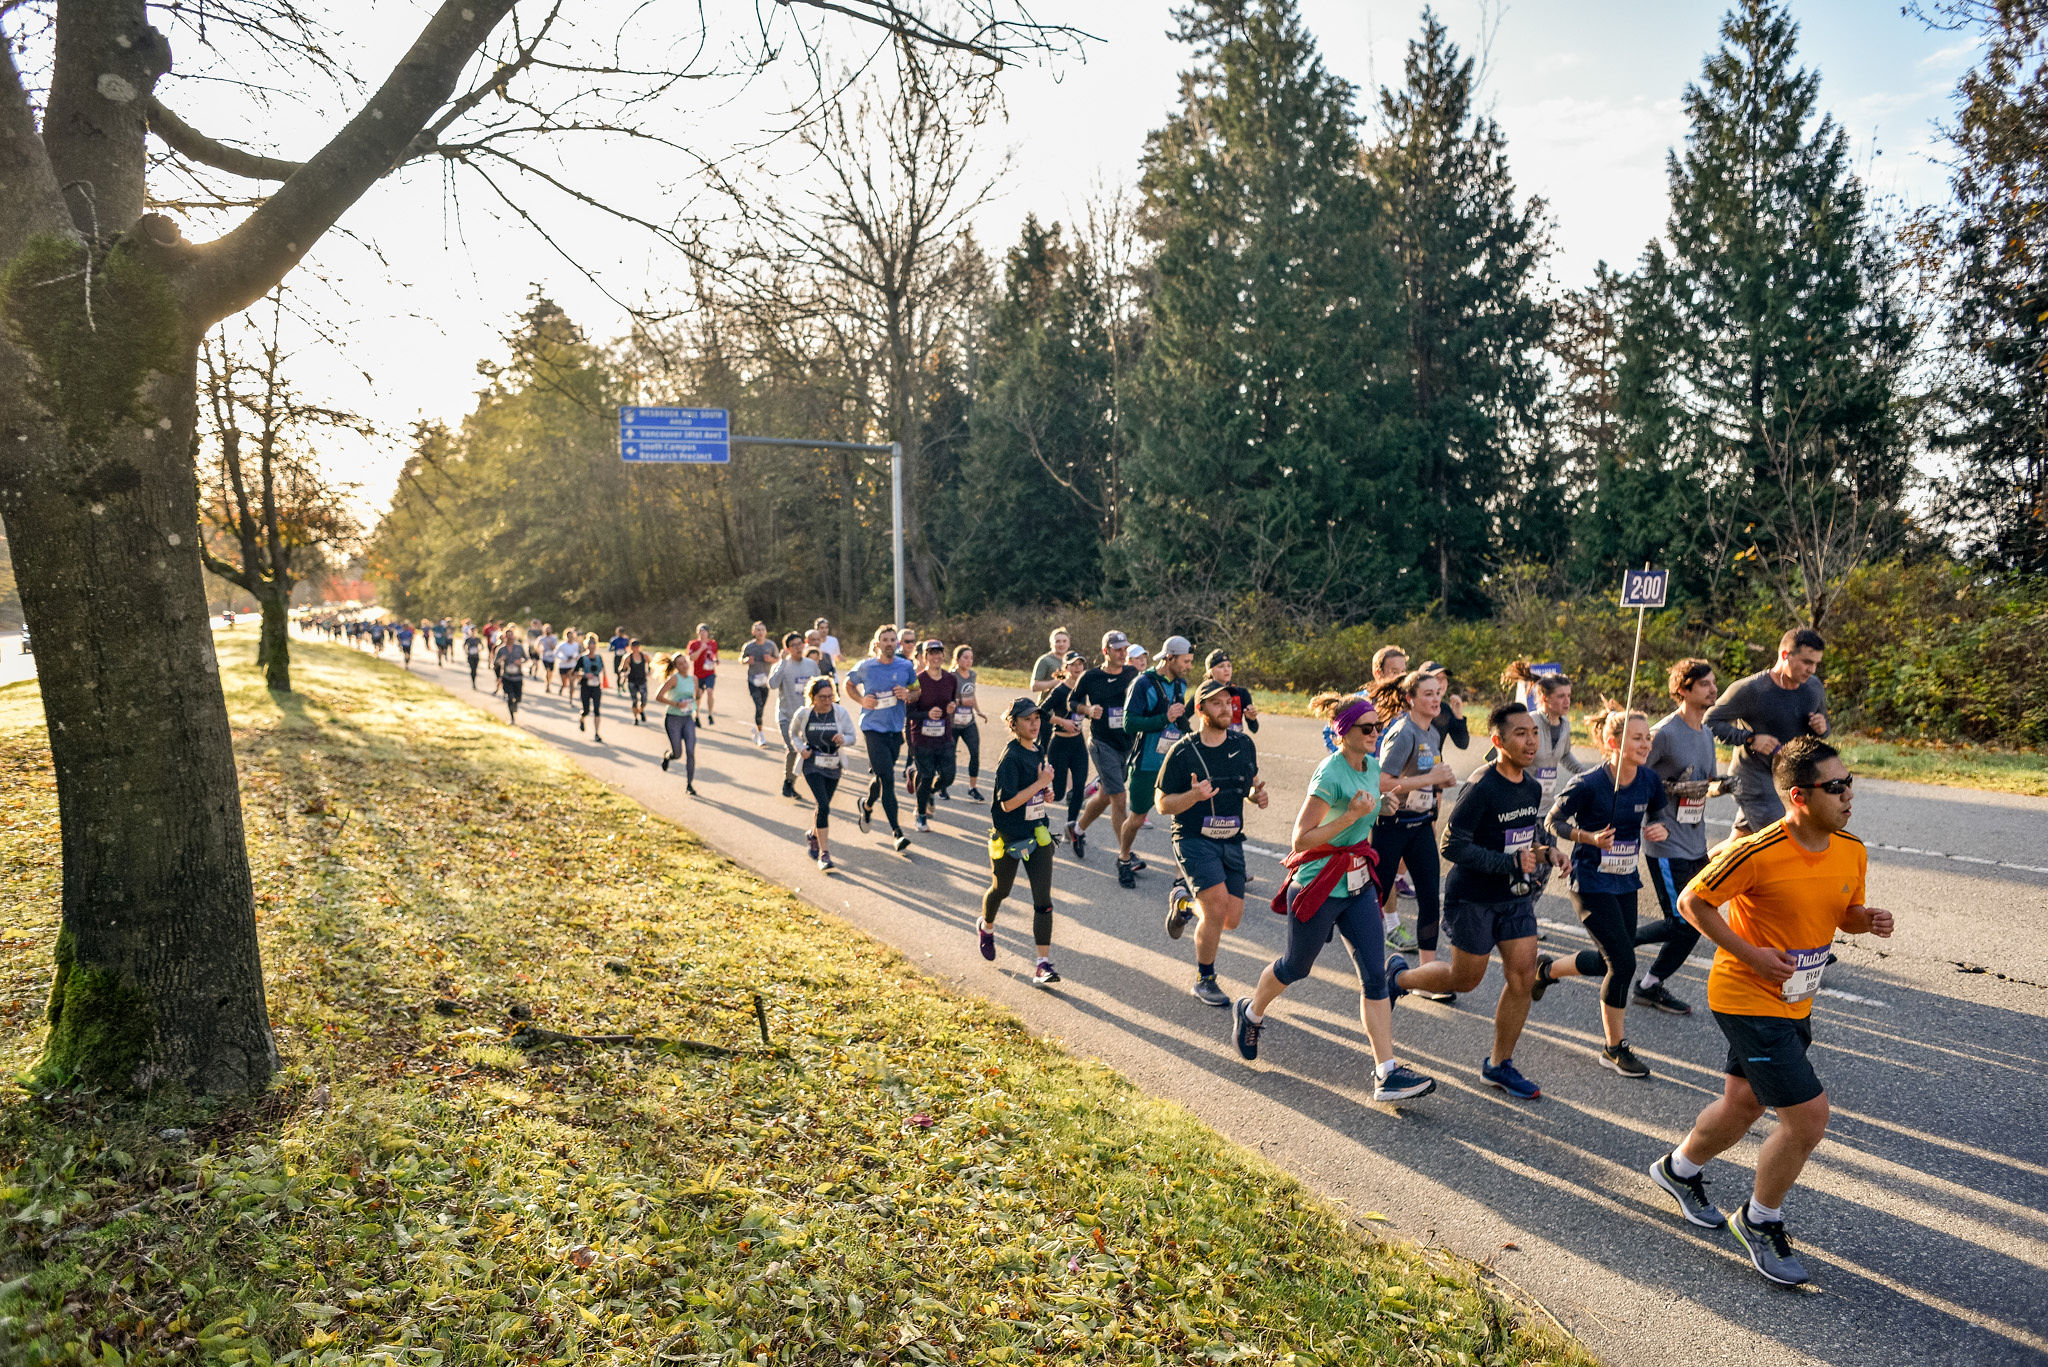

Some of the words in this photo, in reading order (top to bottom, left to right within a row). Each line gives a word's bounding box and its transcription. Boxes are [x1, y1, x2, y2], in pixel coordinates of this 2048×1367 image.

[640, 430, 682, 438] Vancouver
[639, 443, 663, 451] South
[664, 444, 697, 453] Campus
[1630, 575, 1662, 600] 2:00
